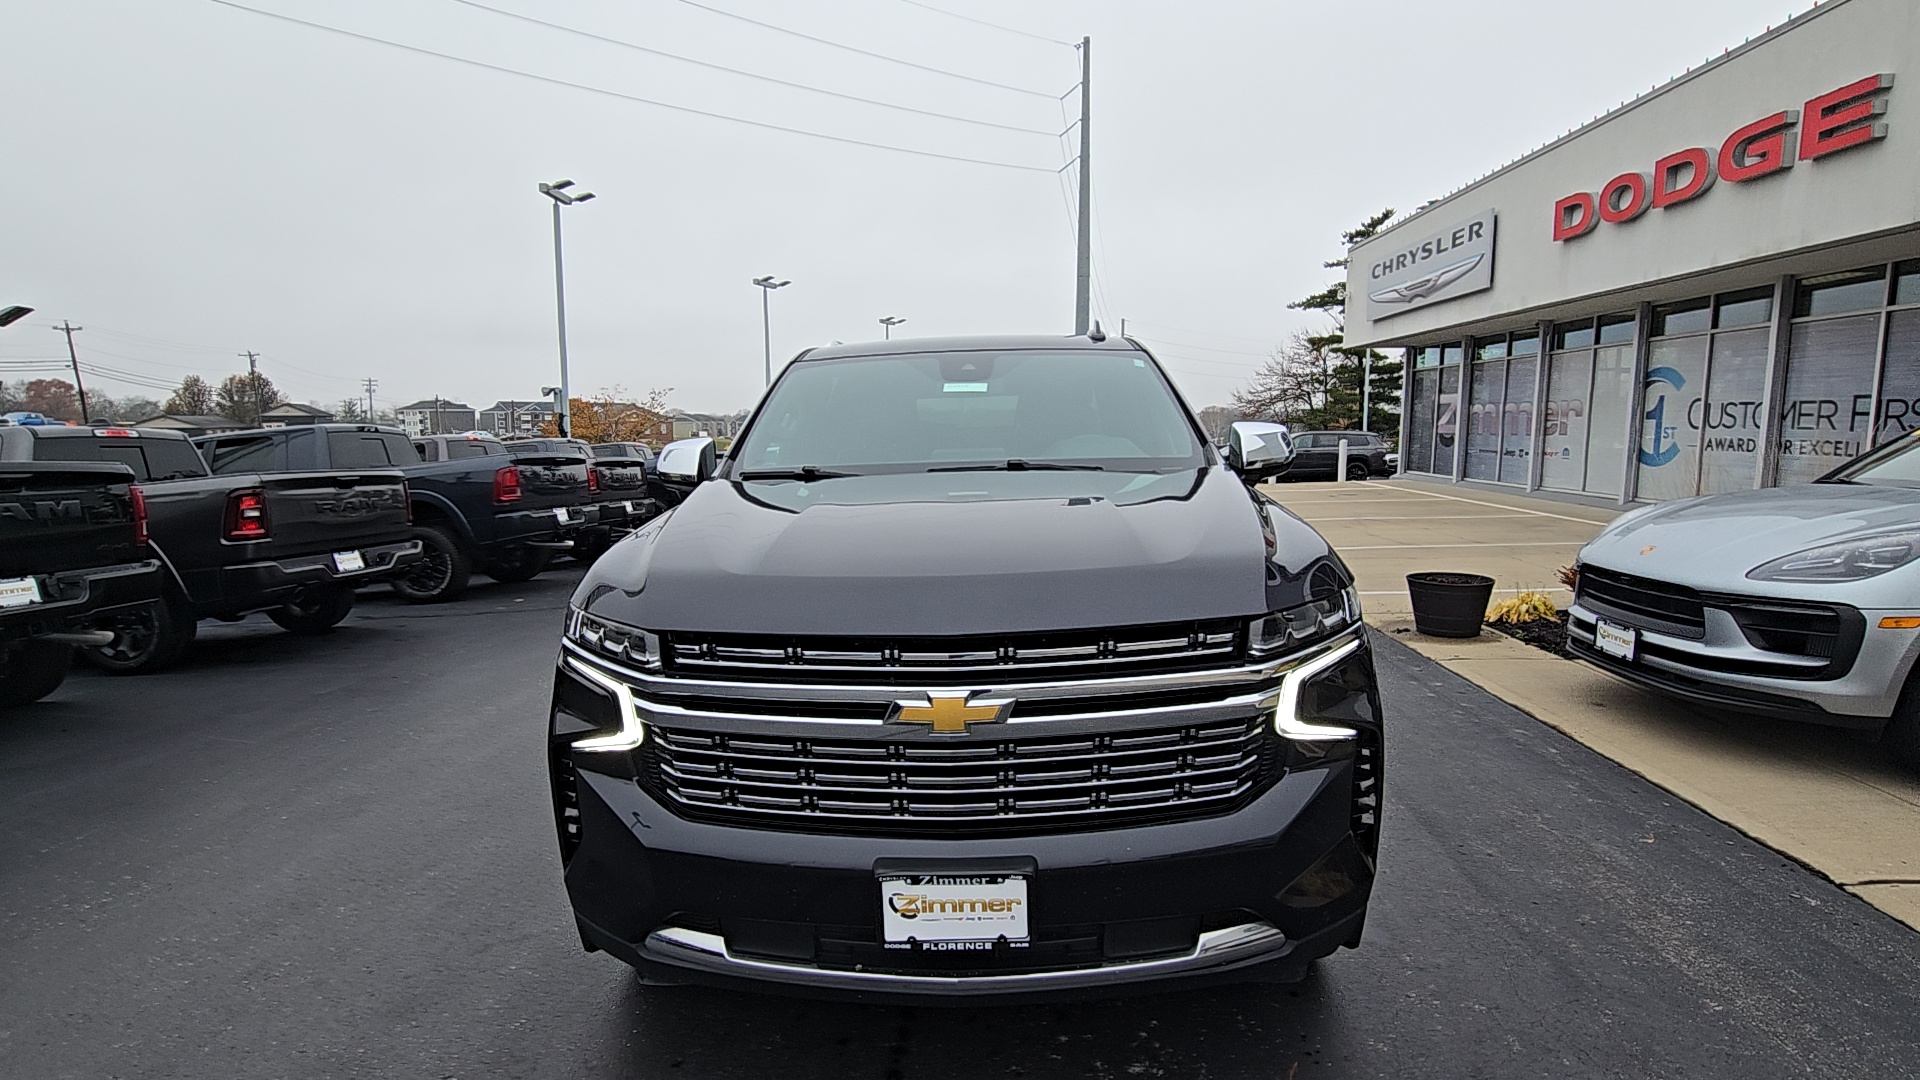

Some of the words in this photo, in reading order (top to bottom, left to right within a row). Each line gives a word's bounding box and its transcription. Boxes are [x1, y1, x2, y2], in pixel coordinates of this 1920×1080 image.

[1553, 73, 1895, 242] DODGE
[1371, 220, 1484, 280] CHRYSLER
[1849, 393, 1920, 433] FRS
[1704, 437, 1756, 453] AWARD
[918, 875, 990, 886] Zimmer
[897, 895, 1021, 914] Zimmer
[922, 942, 993, 951] FLORENCE
